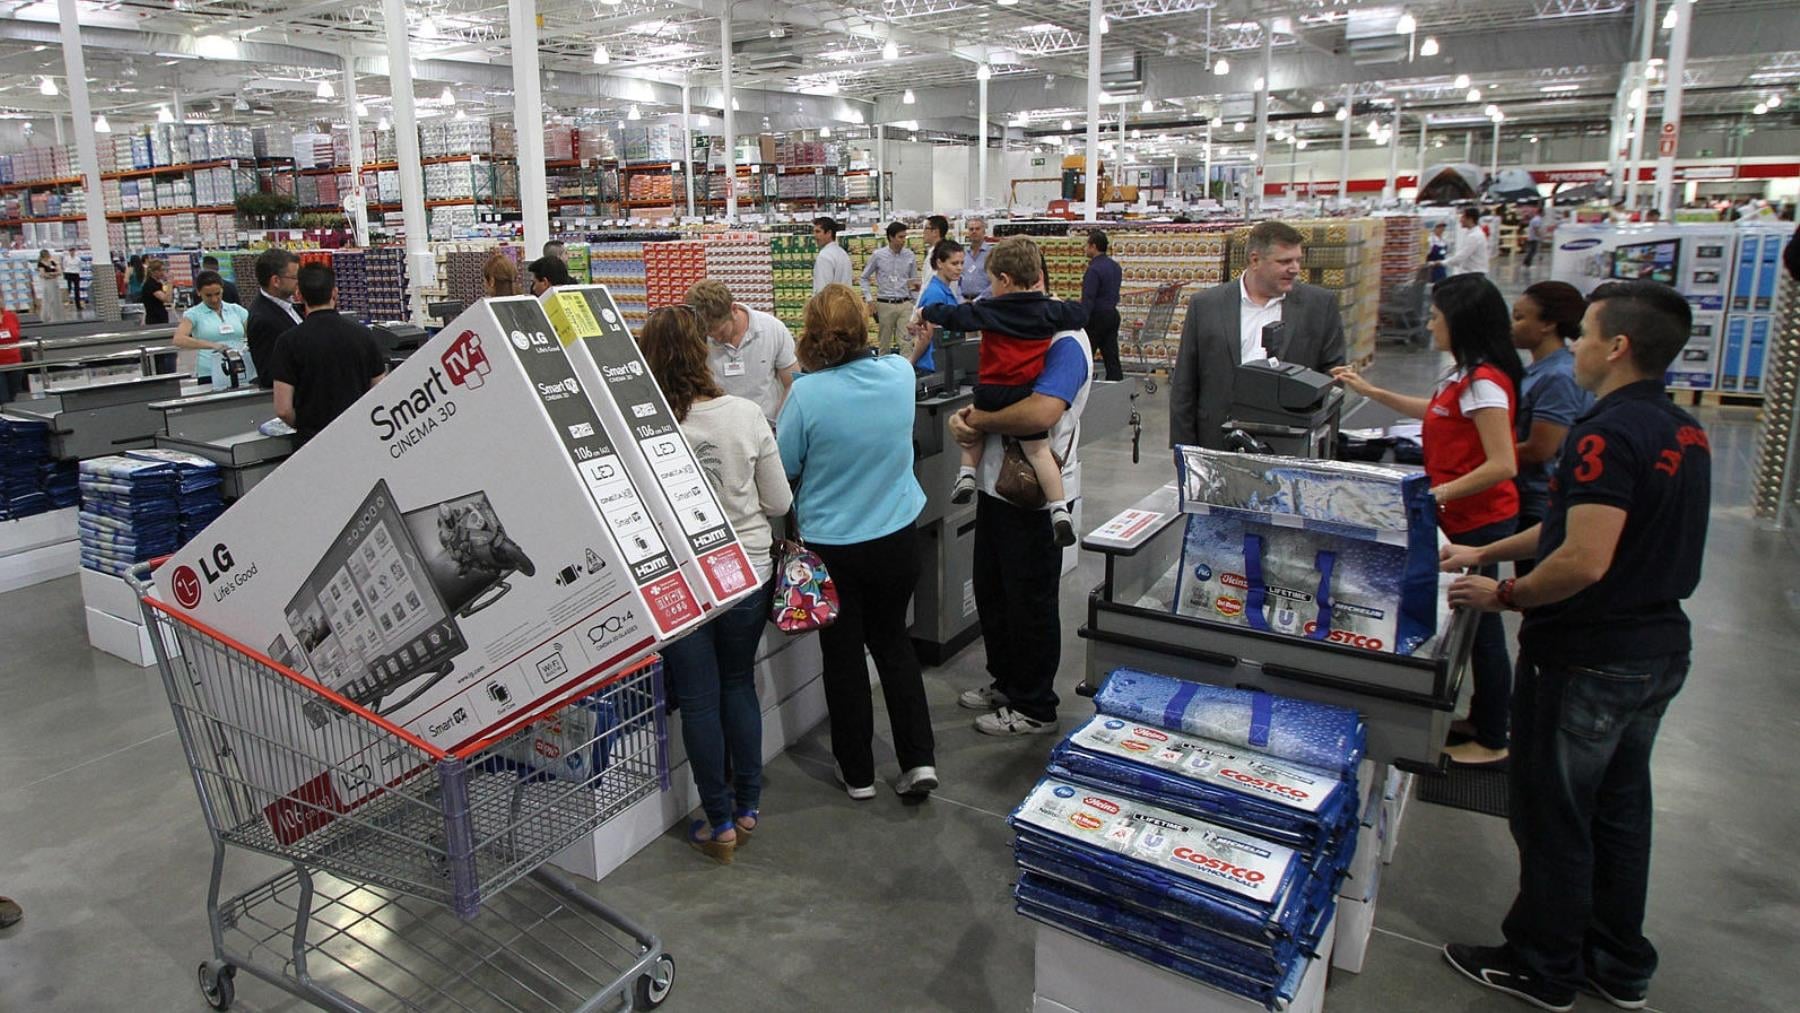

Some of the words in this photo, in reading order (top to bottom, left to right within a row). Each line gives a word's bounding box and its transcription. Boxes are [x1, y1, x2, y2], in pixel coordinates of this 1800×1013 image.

[609, 323, 621, 332] LG
[528, 332, 548, 345] LG
[602, 364, 630, 377] Smart
[370, 366, 448, 441] Smart
[445, 342, 471, 377] TV
[538, 381, 566, 395] Smart
[390, 417, 439, 459] CINEMA
[438, 401, 457, 422] 3D
[636, 424, 655, 438] 106
[574, 446, 593, 460] 106
[652, 442, 677, 457] LED
[1573, 434, 1606, 482] 3
[590, 464, 615, 481] LED
[614, 516, 632, 528] Smart
[692, 527, 727, 548] HDMI
[199, 543, 235, 585] LG
[634, 556, 669, 578] HDMI
[213, 581, 236, 603] Life's
[234, 562, 259, 587] Good
[1222, 574, 1248, 587] Heinz
[1269, 586, 1307, 601] LIFETIME
[1334, 602, 1383, 618] MICHELIN
[1303, 621, 1383, 651] CSTCO
[428, 716, 456, 738] Smart
[1137, 728, 1166, 741] Heinz
[341, 763, 372, 792] LED
[1220, 768, 1310, 798] COSTCO
[1086, 797, 1118, 814] Heinz
[279, 803, 304, 831] 106
[1140, 815, 1183, 832] LIFETIME
[1217, 837, 1269, 856] MICHELIN
[1173, 847, 1265, 882] COSTCO
[1197, 865, 1260, 889] WHOLESALE
